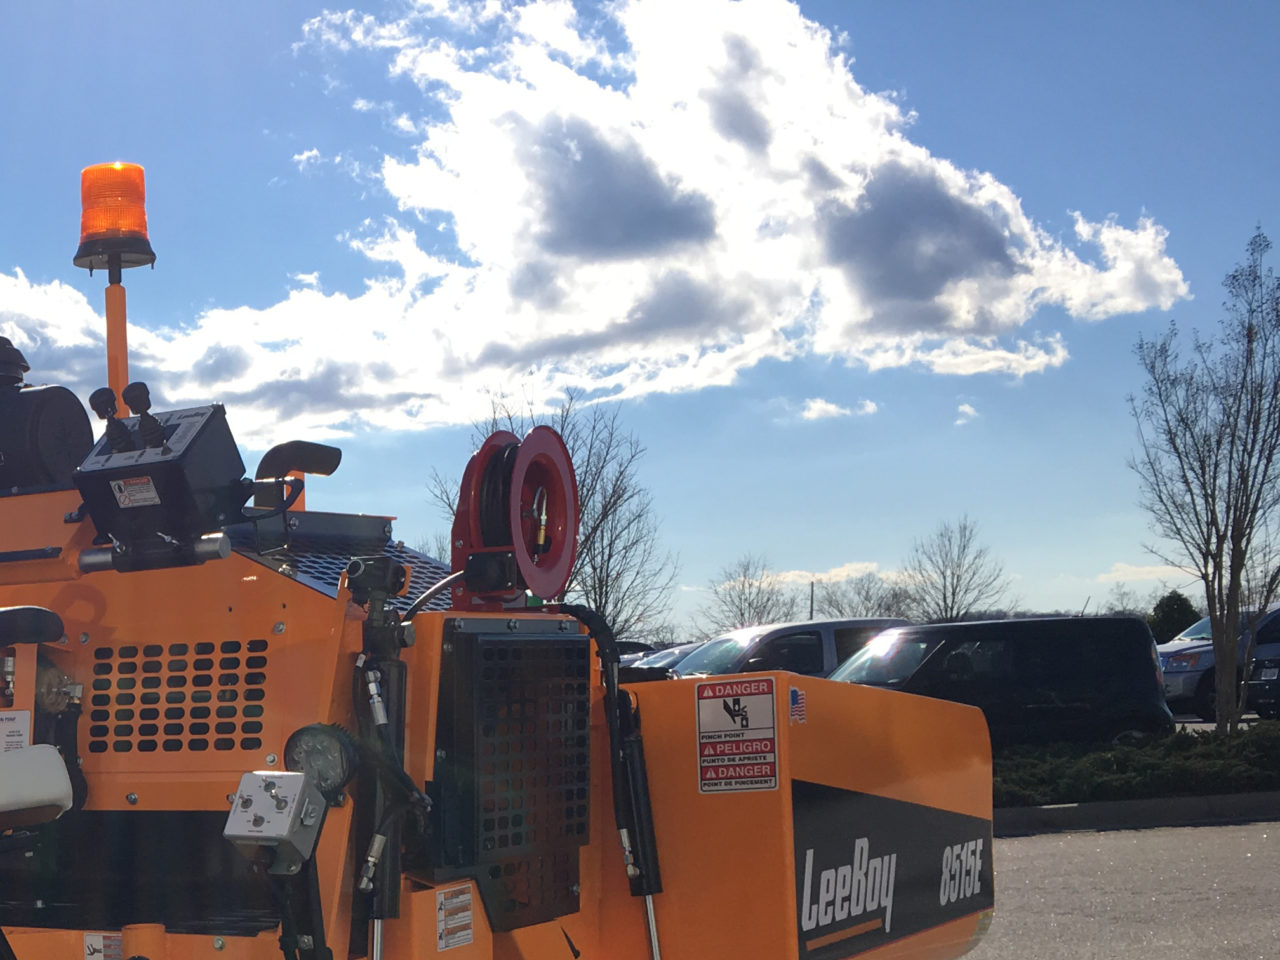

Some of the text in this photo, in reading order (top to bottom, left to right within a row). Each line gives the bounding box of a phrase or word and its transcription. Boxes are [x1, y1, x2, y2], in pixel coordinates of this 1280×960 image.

[716, 682, 768, 696] DANGER
[716, 741, 771, 754] PELIGRO
[702, 757, 725, 765] PUNTO
[719, 765, 771, 778] DANGER
[734, 778, 773, 786] PINCEMENT
[801, 837, 983, 933] LeeBoy 8515E
